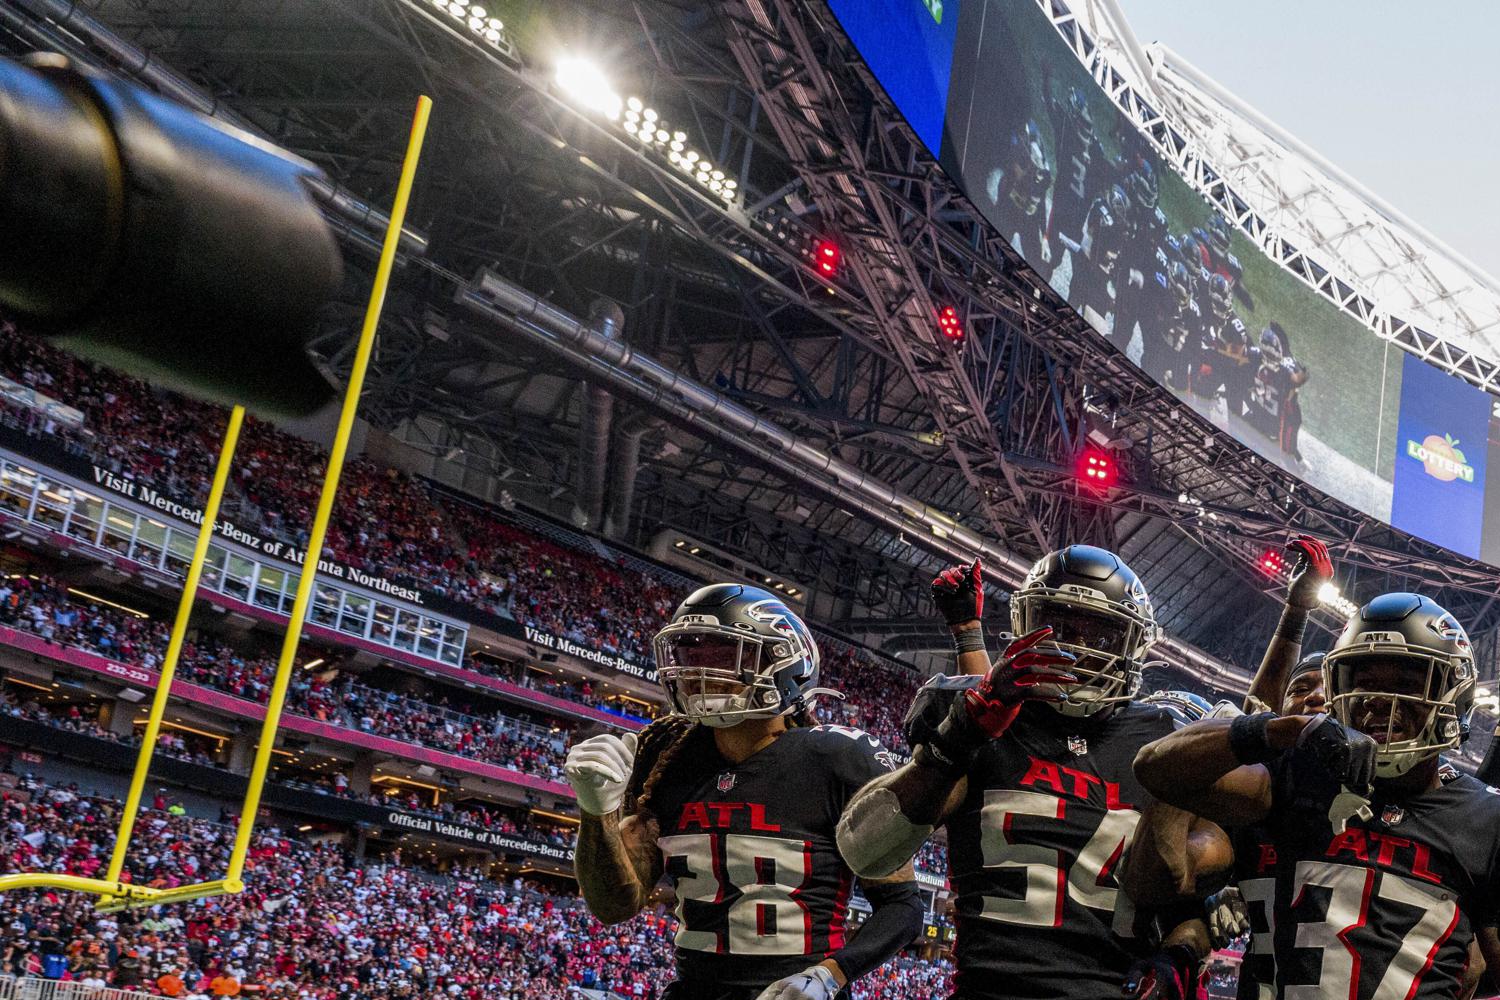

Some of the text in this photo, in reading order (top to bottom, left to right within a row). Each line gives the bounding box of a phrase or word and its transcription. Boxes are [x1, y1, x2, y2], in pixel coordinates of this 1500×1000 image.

[1408, 442, 1473, 479] LOTTERY
[92, 465, 136, 497] Visit
[263, 542, 284, 556] of
[347, 566, 424, 604] Northeast.
[682, 615, 705, 623] ATL
[1364, 632, 1391, 642] ATL
[524, 626, 659, 683] Visit Mercedes-Benz of
[1019, 754, 1135, 810] ATL
[388, 812, 432, 832] Official
[434, 822, 474, 840] Vehicle
[477, 832, 489, 843] of
[490, 834, 565, 860] Mercedes-Benz
[677, 801, 782, 833] ATL
[914, 871, 945, 887] Stadium
[979, 789, 1143, 939] 54
[1325, 827, 1443, 884] ATL
[657, 833, 814, 956] 28
[927, 925, 938, 938] 25
